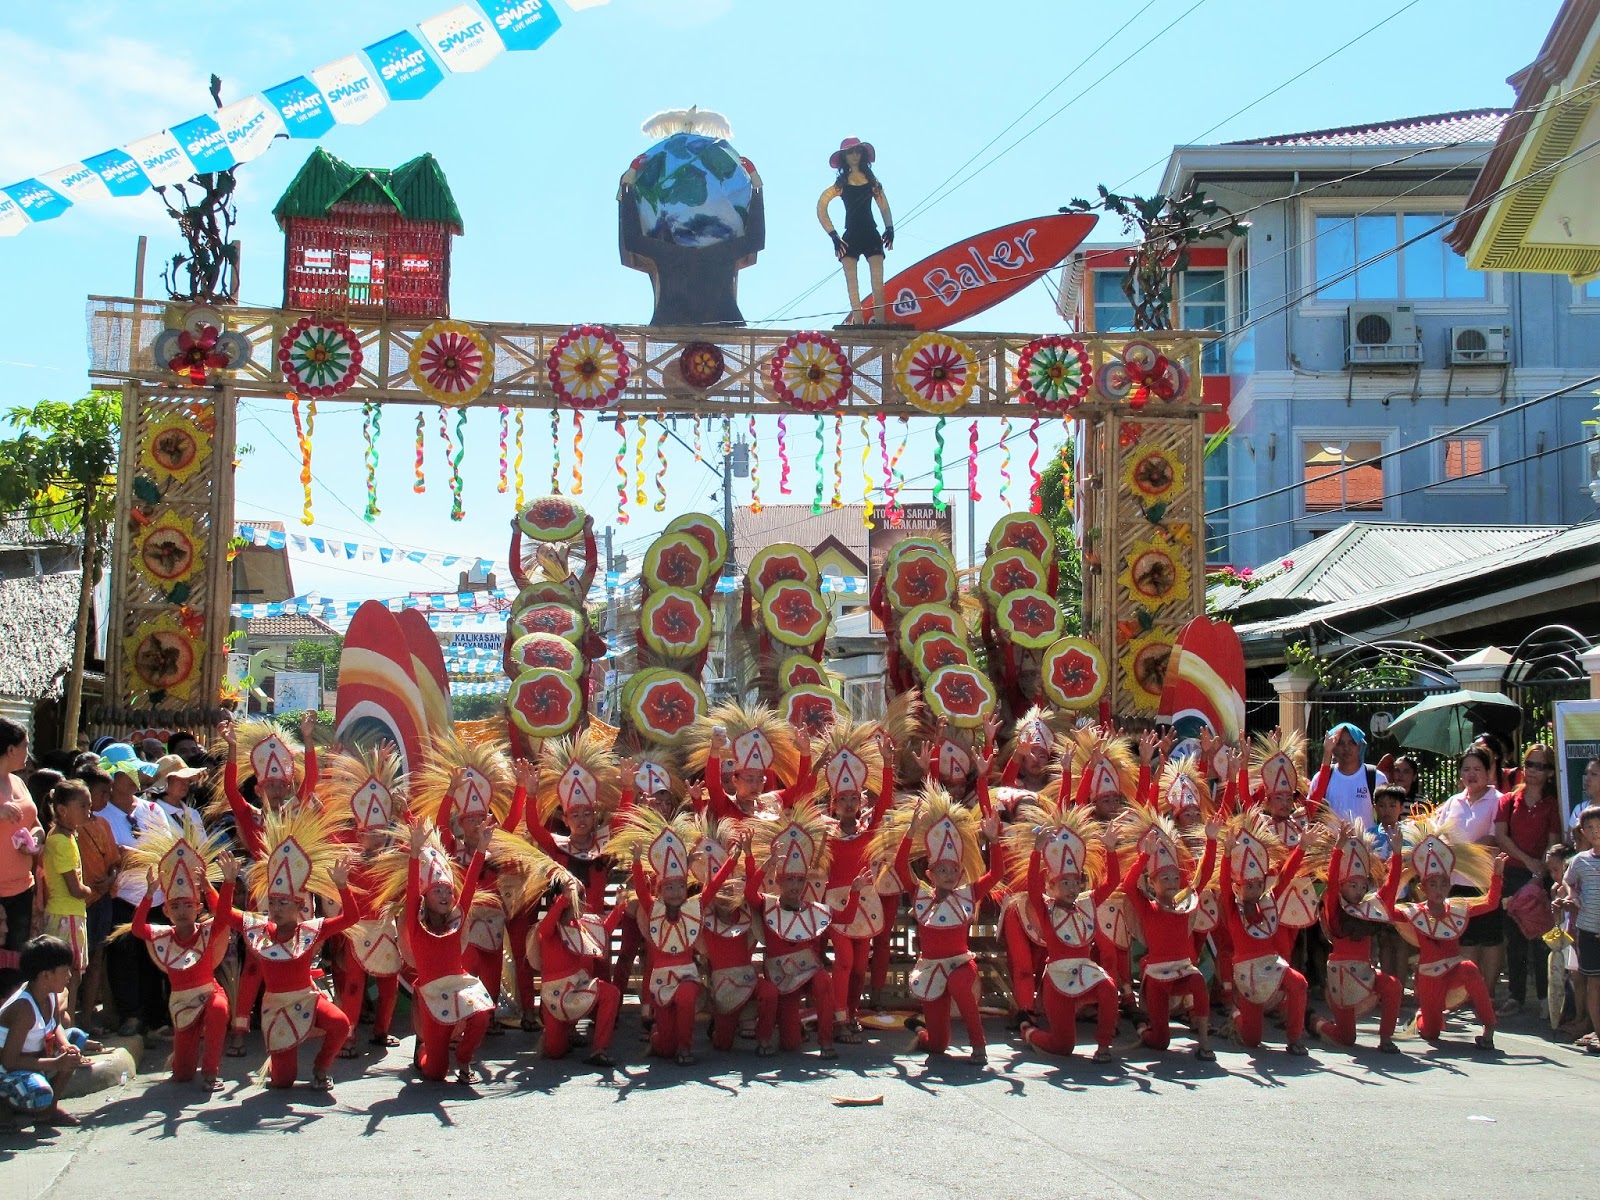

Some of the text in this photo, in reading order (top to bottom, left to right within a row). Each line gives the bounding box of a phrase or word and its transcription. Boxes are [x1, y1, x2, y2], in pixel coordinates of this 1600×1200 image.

[495, 0, 543, 30] SMART
[438, 22, 485, 53] SMART
[381, 49, 426, 80] SMART
[328, 77, 370, 103] SMART
[282, 93, 323, 119] SMART
[227, 111, 265, 143] SMART
[101, 160, 138, 181] SMART
[143, 148, 180, 169] SMART
[923, 228, 1037, 307] Baler
[907, 508, 934, 519] SARAP
[455, 633, 501, 642] KALIKASAN
